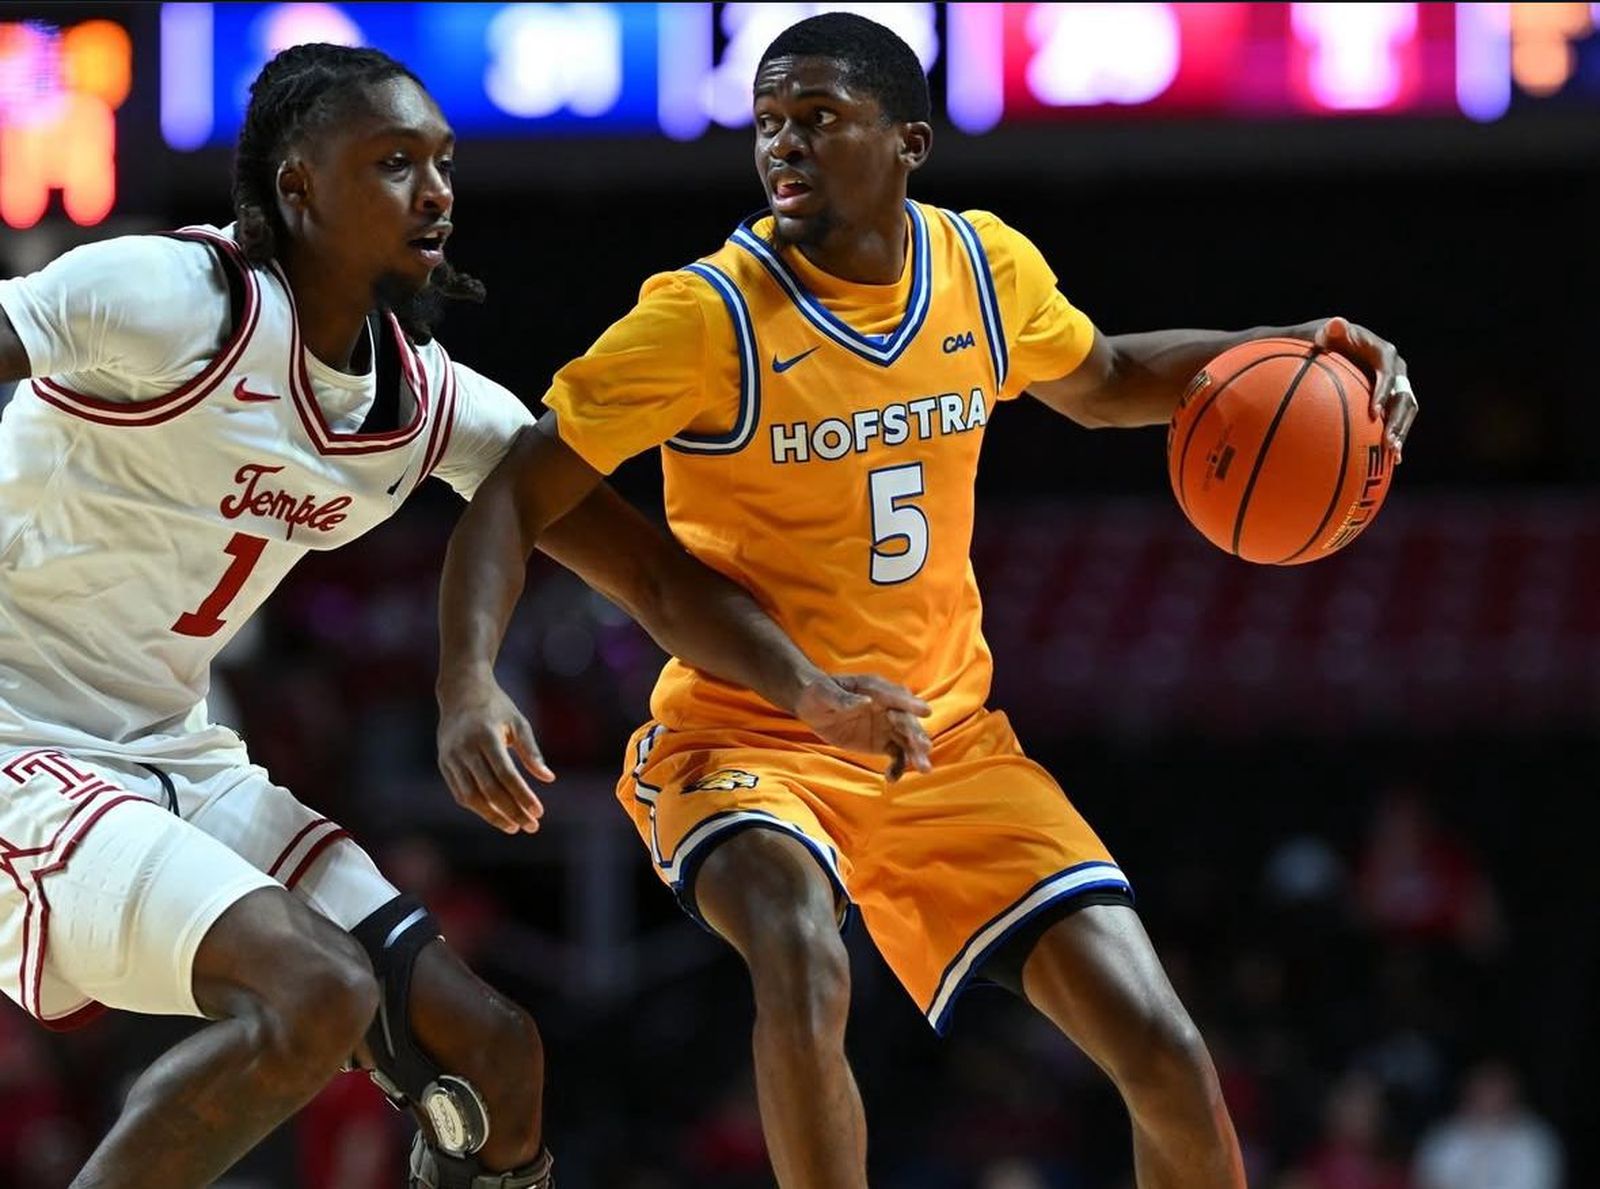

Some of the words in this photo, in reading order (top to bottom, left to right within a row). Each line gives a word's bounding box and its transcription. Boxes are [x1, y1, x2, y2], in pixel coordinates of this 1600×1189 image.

[942, 331, 976, 354] CAA
[770, 388, 988, 464] HOFSTRA
[220, 463, 353, 541] Temple
[868, 461, 929, 585] 5
[170, 532, 270, 638] 1
